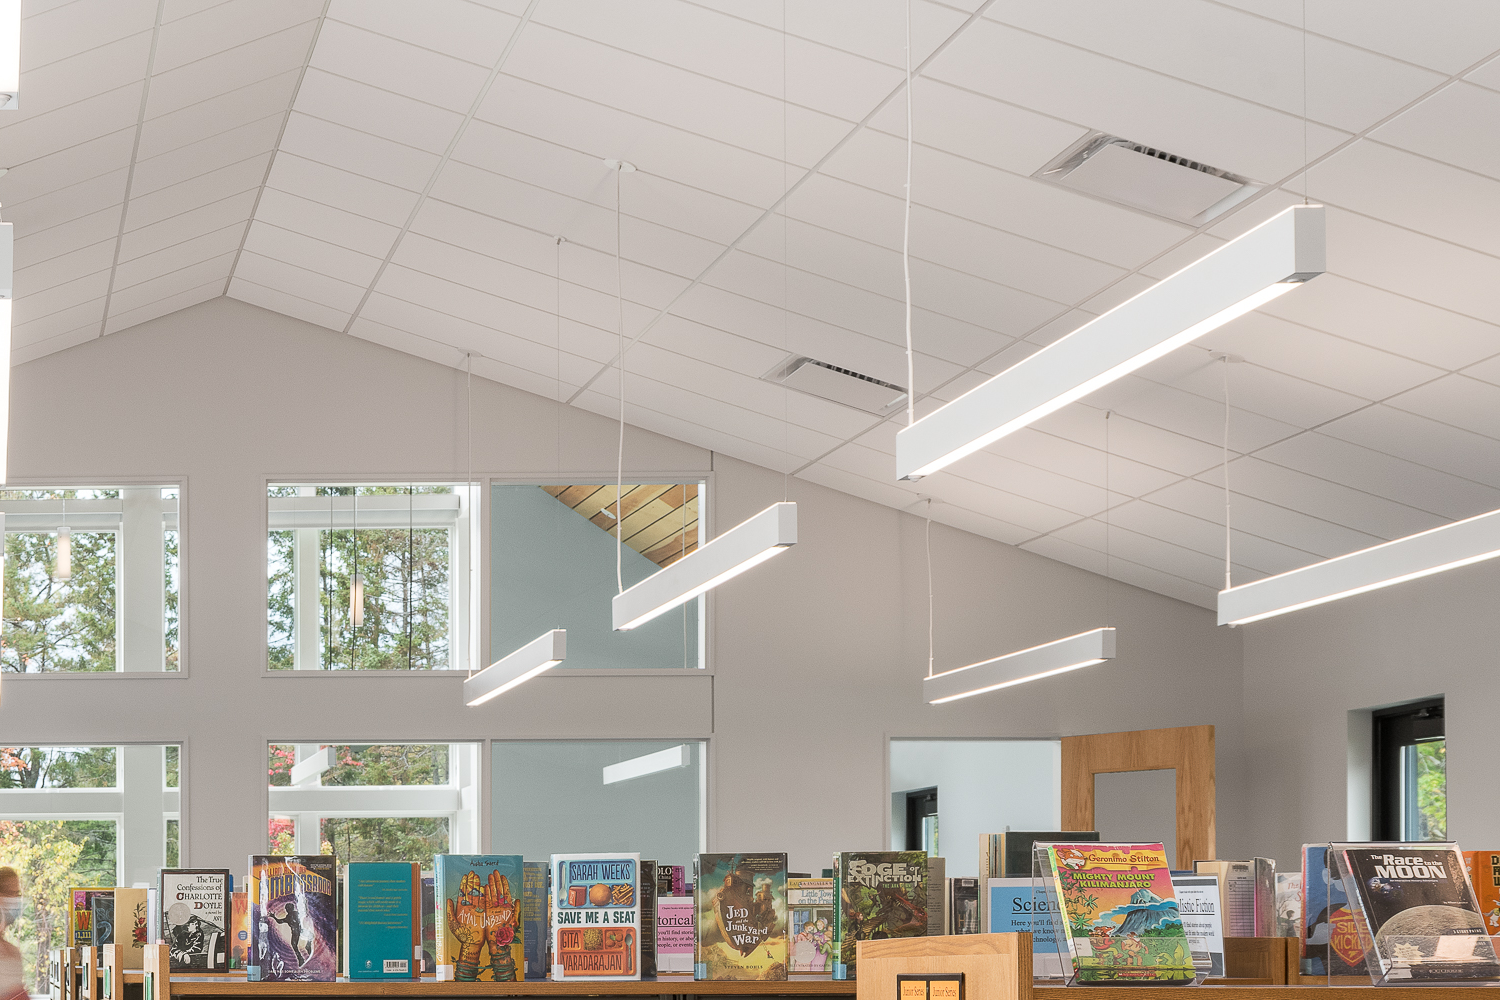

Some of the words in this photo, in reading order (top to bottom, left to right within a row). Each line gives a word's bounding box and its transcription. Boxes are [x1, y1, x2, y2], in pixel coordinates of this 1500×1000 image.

[1088, 854, 1127, 863] Geronimo
[1383, 855, 1423, 866] Race
[572, 864, 598, 880] SARAH
[602, 864, 630, 880] WEEKS
[848, 860, 907, 876] EDGE
[1374, 865, 1447, 878] MOON
[848, 874, 921, 886] EXTINCTION
[176, 884, 214, 892] Confessions
[215, 883, 223, 892] of
[801, 890, 817, 898] Little
[819, 890, 833, 898] Tow
[194, 902, 223, 910] DOYLE
[1012, 897, 1061, 911] Scienc
[1196, 898, 1215, 912] Fiction
[457, 910, 477, 927] AMAL
[479, 909, 511, 929] UNBOUND
[557, 911, 581, 924] SAVE
[586, 911, 599, 924] ME
[603, 911, 609, 924] A
[613, 911, 635, 923] SEAT
[726, 906, 748, 919] JED
[658, 914, 694, 926] torical
[726, 921, 768, 934] Junkyard
[1336, 922, 1366, 933] SIDE
[562, 932, 580, 948] GITA
[732, 934, 759, 946] War
[1334, 934, 1373, 950] KICKED
[562, 955, 622, 971] VARADARAJAN
[902, 986, 914, 996] Junior
[914, 986, 925, 996] Series
[932, 987, 945, 997] Junior
[946, 987, 956, 997] Series
